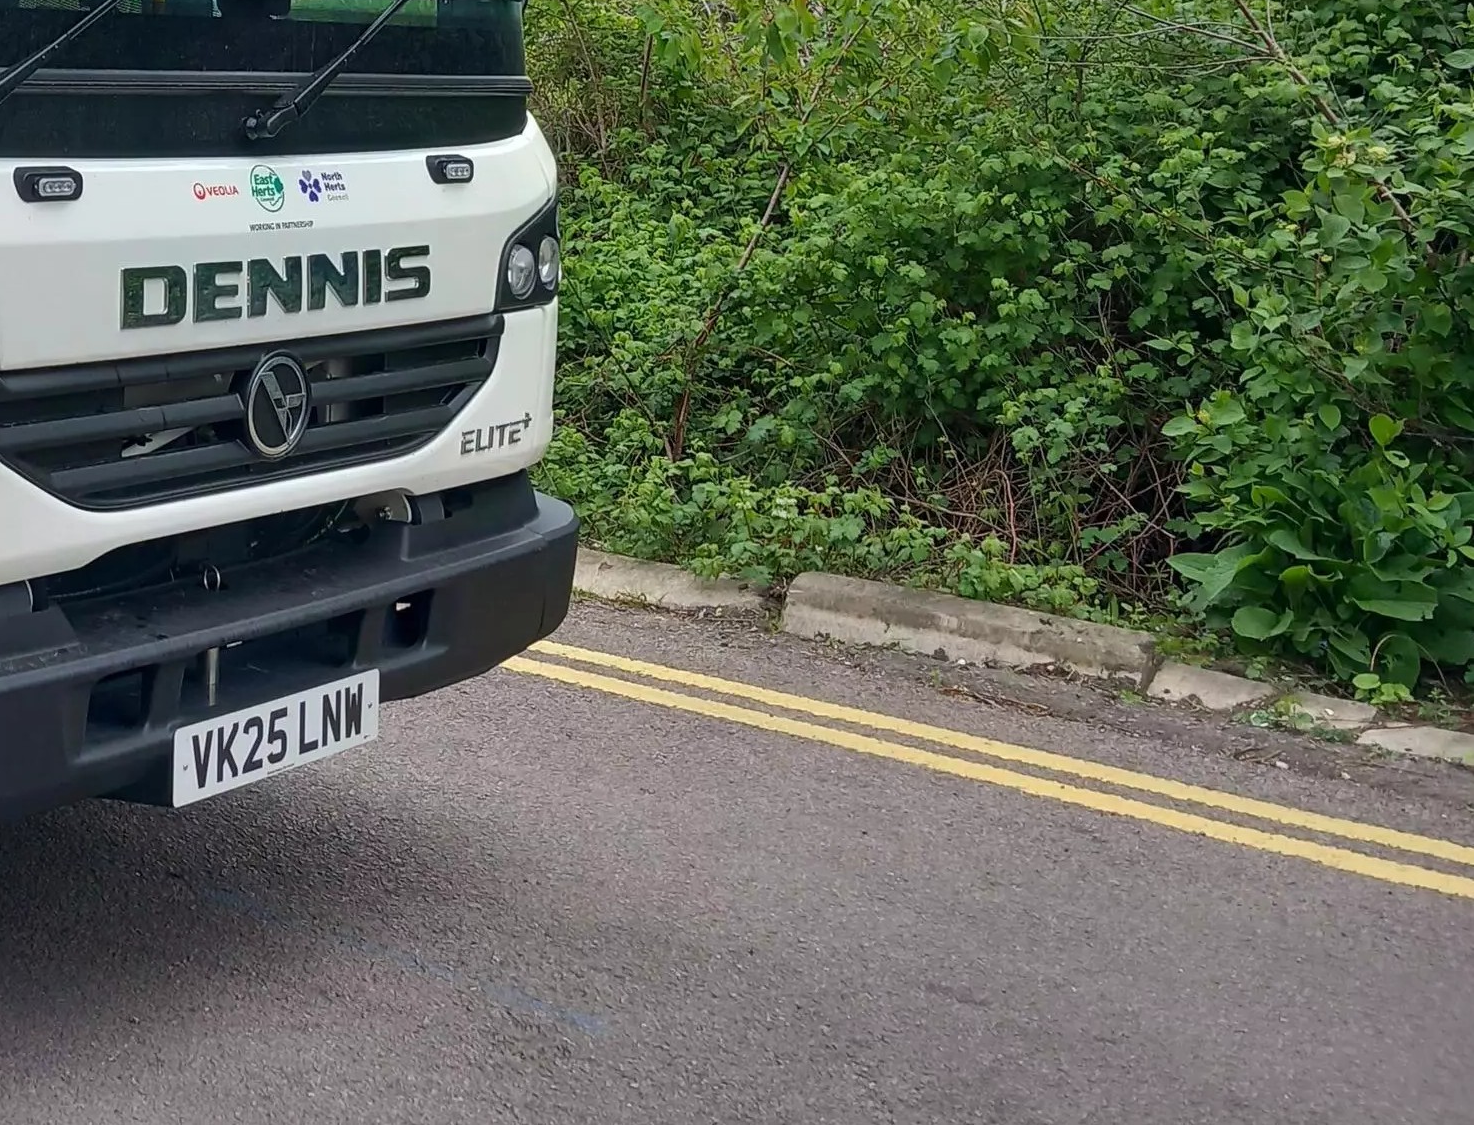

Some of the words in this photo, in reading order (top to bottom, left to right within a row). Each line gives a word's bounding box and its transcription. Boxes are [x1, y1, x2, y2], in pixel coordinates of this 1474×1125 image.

[254, 174, 274, 186] East
[321, 172, 343, 181] North
[206, 185, 240, 197] VEOLIA
[251, 186, 276, 197] Herts
[324, 181, 346, 191] Herts
[249, 223, 275, 231] WORKING
[275, 222, 281, 230] IN
[282, 220, 314, 229] PARTNERSHIP
[120, 244, 431, 330] DENNIS
[191, 706, 289, 790] VK25
[298, 682, 364, 756] LNW
